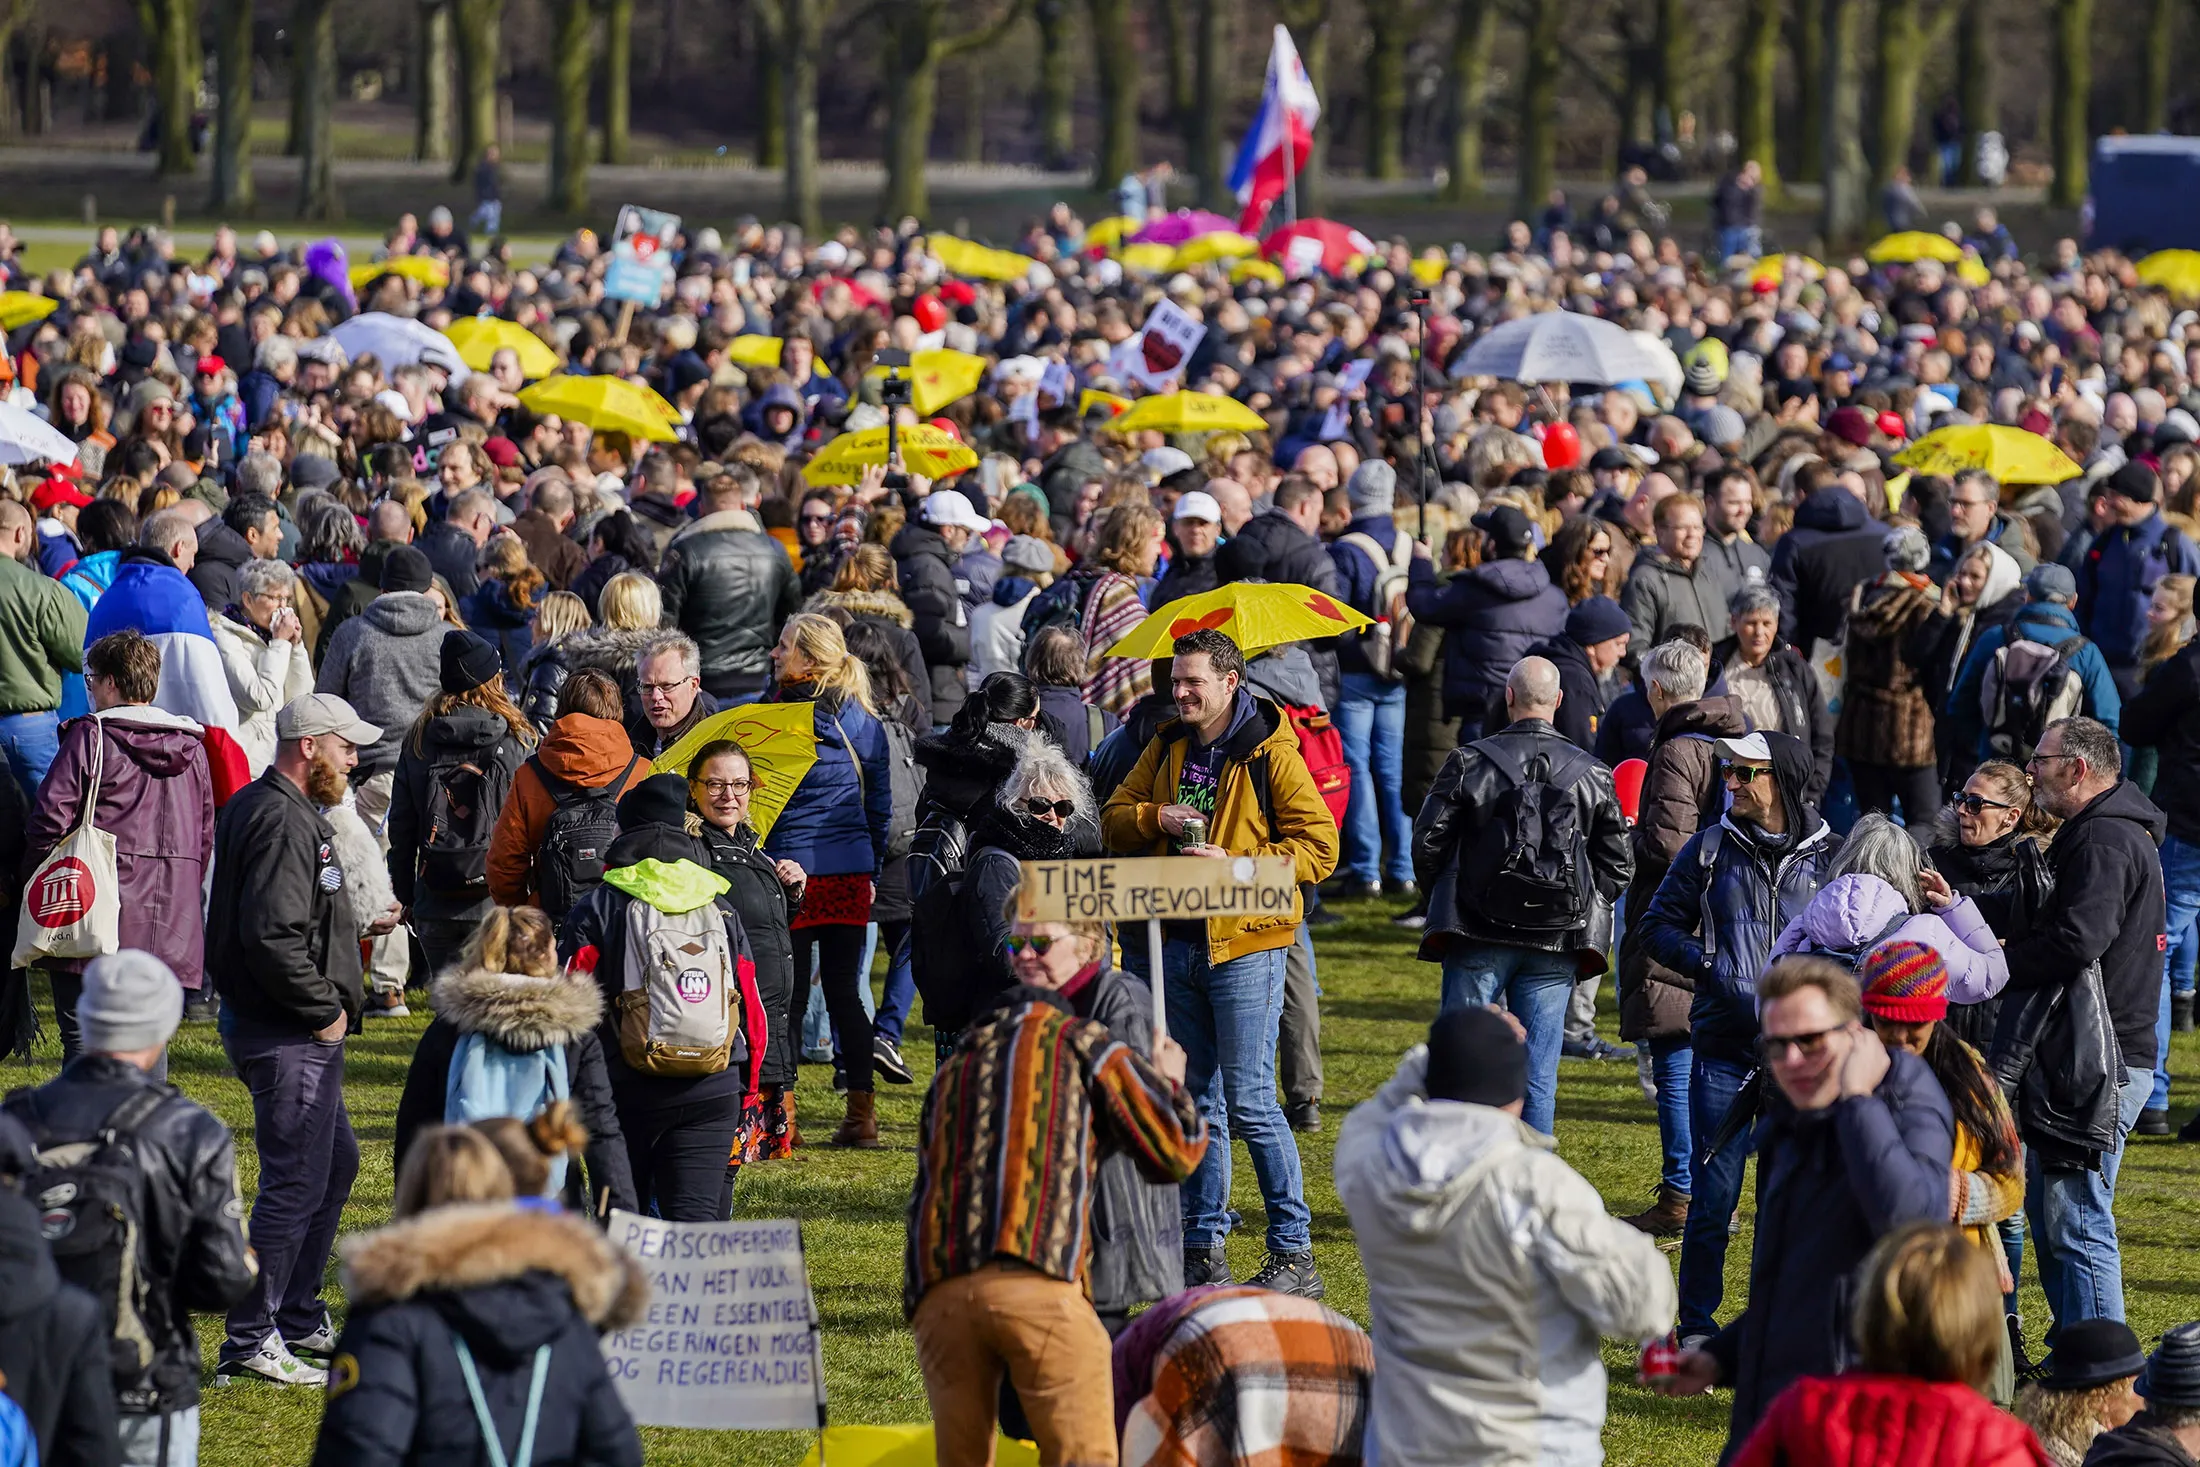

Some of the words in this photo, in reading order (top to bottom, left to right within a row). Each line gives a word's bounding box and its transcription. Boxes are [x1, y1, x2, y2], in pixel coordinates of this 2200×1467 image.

[1065, 891, 1119, 919] FOR
[648, 1269, 691, 1295] AN
[702, 1268, 739, 1296] HET
